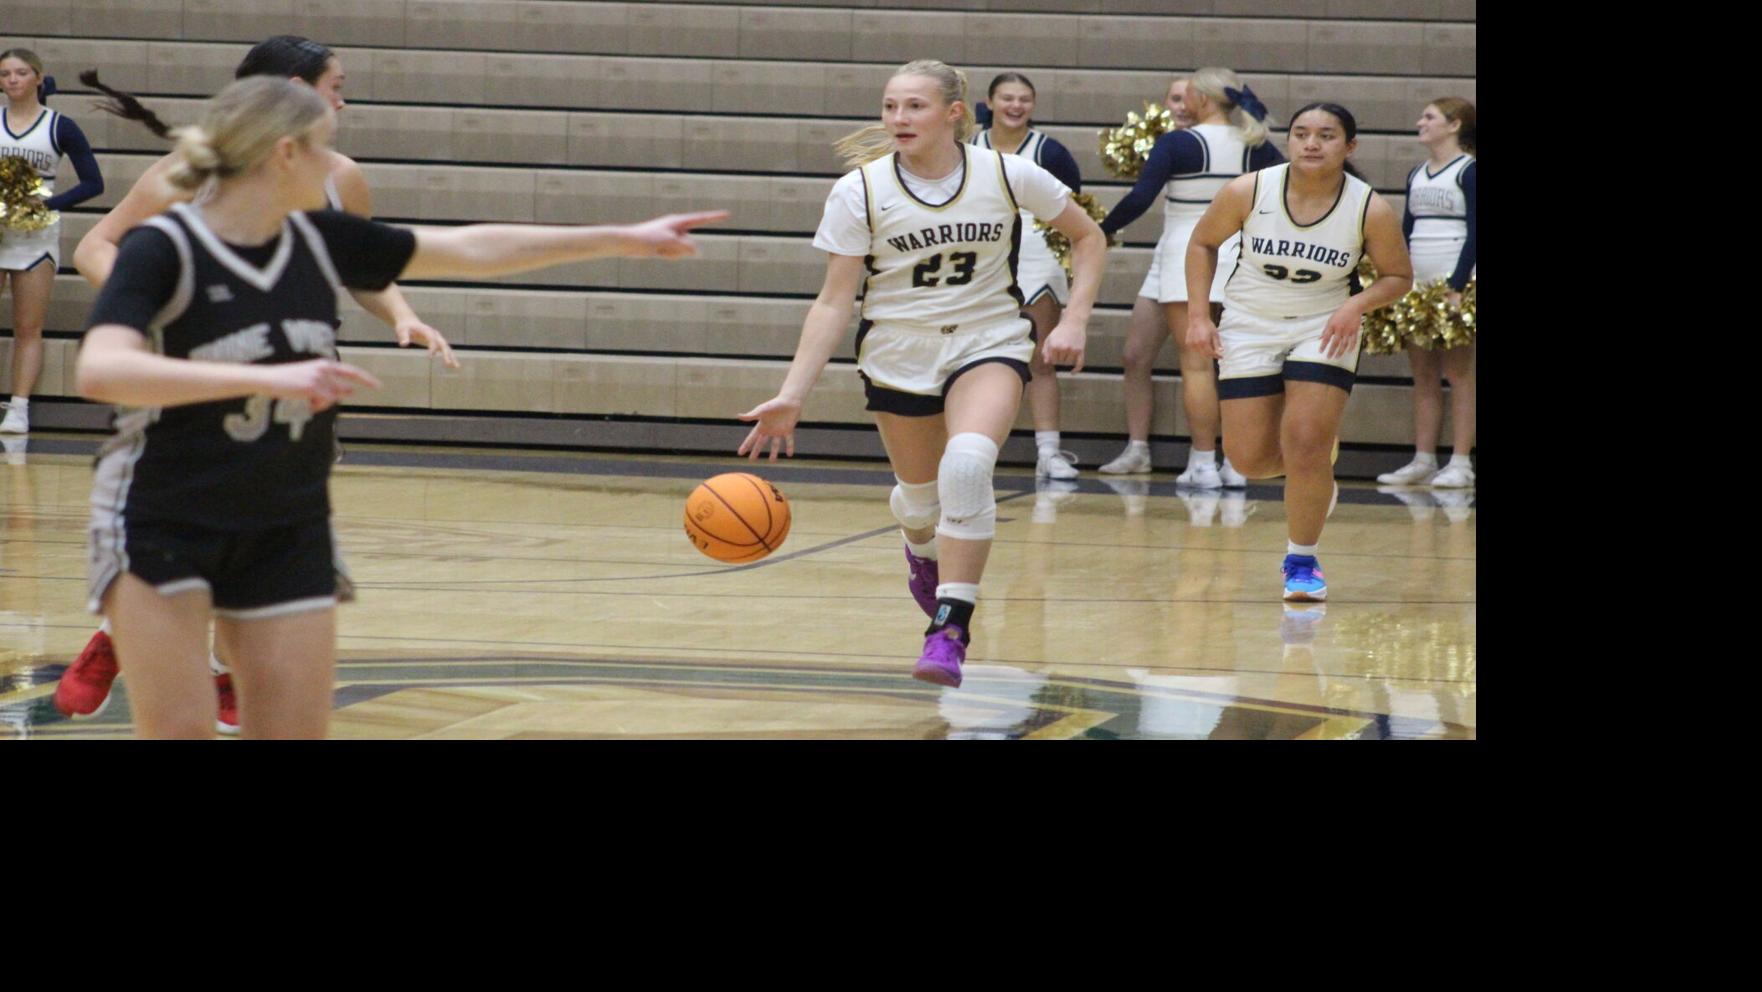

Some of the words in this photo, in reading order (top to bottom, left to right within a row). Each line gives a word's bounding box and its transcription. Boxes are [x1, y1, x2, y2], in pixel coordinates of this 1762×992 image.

[887, 223, 1003, 252] WARRIORS
[1252, 237, 1350, 267] WARRIORS
[912, 251, 977, 288] 23
